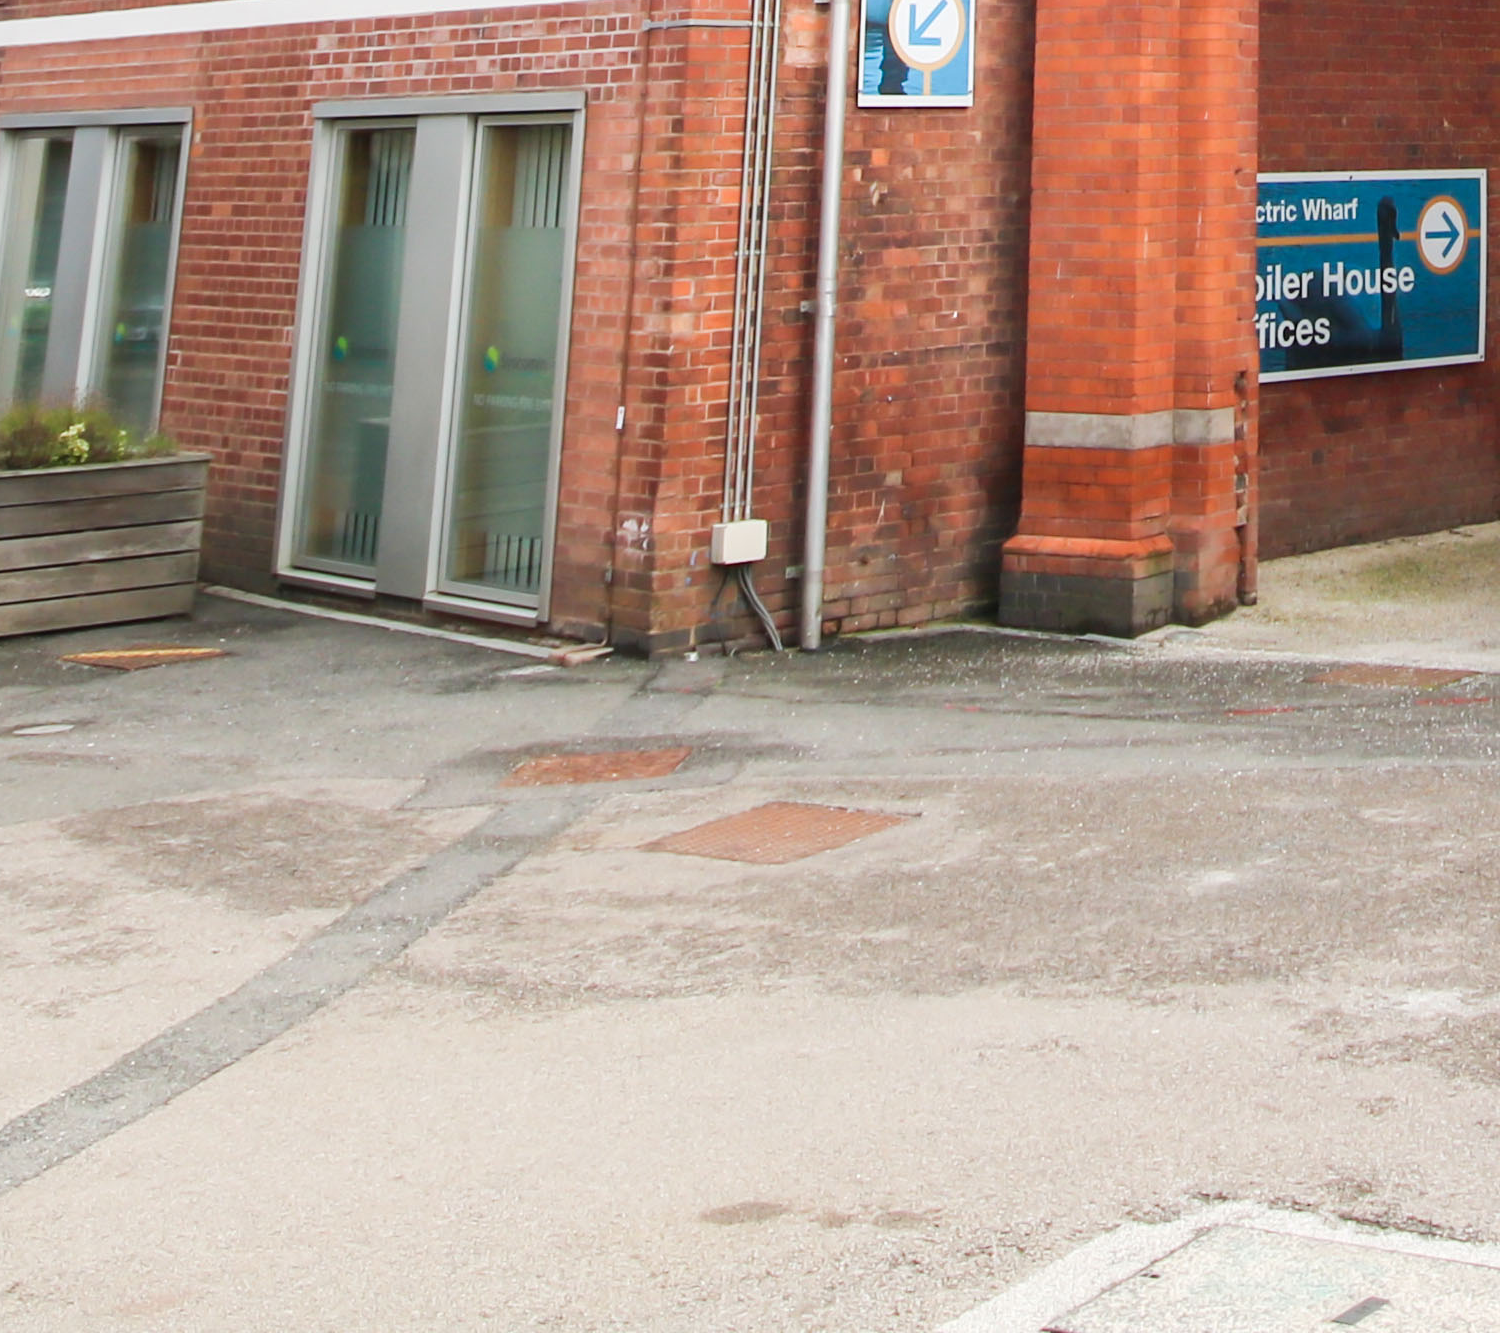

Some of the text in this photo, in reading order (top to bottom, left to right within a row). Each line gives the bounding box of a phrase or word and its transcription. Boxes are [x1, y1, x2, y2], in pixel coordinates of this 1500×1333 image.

[1255, 197, 1359, 223] ctric Wharf
[1323, 261, 1415, 297] House
[1254, 312, 1331, 350] fices
